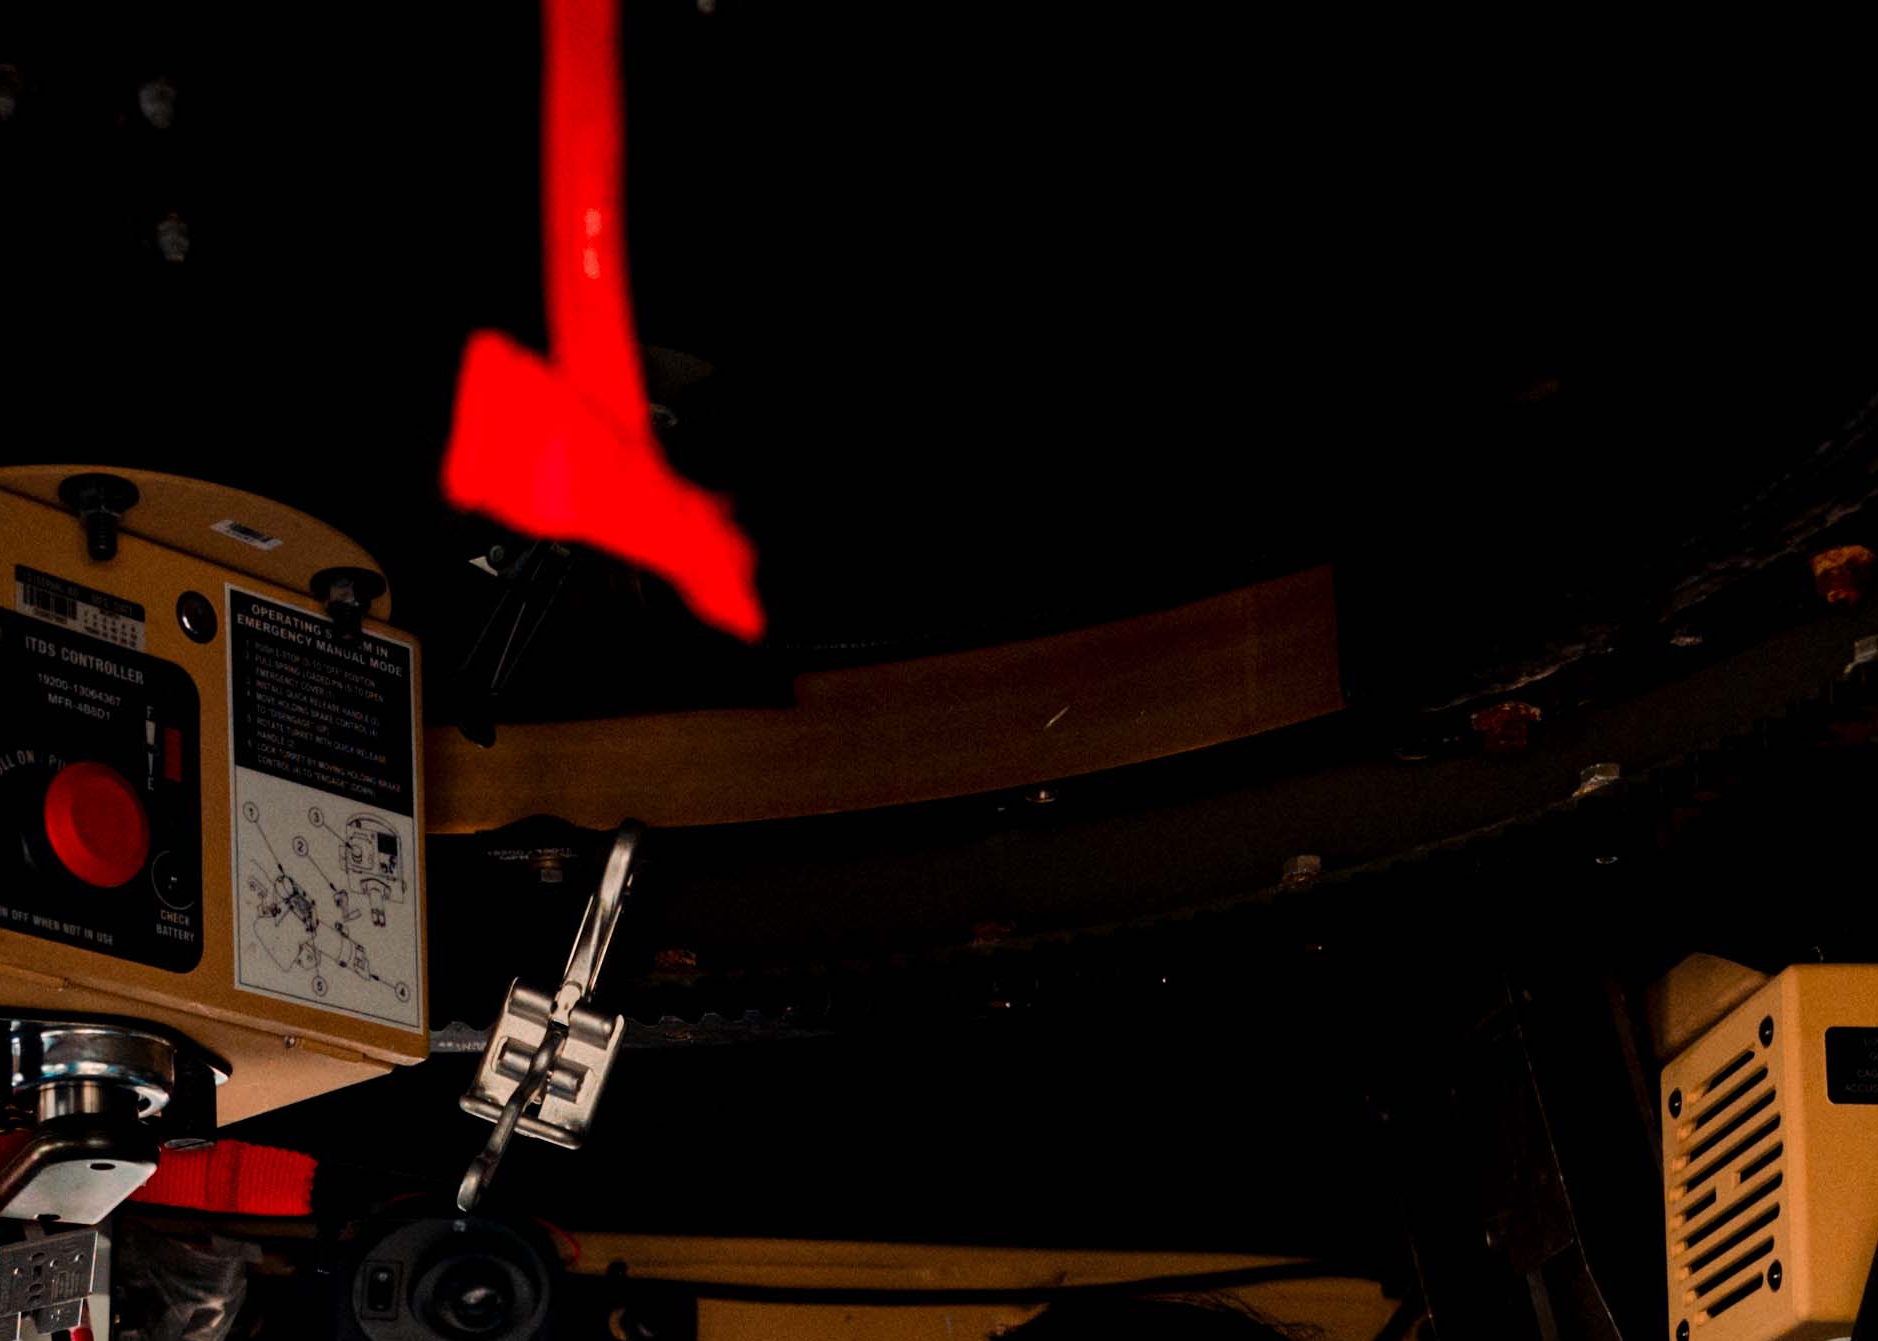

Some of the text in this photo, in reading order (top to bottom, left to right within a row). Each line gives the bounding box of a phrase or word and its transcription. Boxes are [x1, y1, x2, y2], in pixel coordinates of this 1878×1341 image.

[236, 612, 312, 649] EMERGENCY
[315, 638, 366, 666] MANUAL
[369, 655, 402, 678] MODE
[250, 602, 388, 658] OPERATING IN
[24, 635, 144, 685] ITDS CONTROLLER
[16, 749, 34, 765] ON
[10, 909, 30, 923] OFF
[32, 914, 60, 931] WHEN
[62, 921, 82, 937] NOT
[84, 927, 94, 939] IN
[96, 930, 114, 946] USE
[156, 923, 195, 943] BATTERY
[160, 909, 191, 926] CHECK
